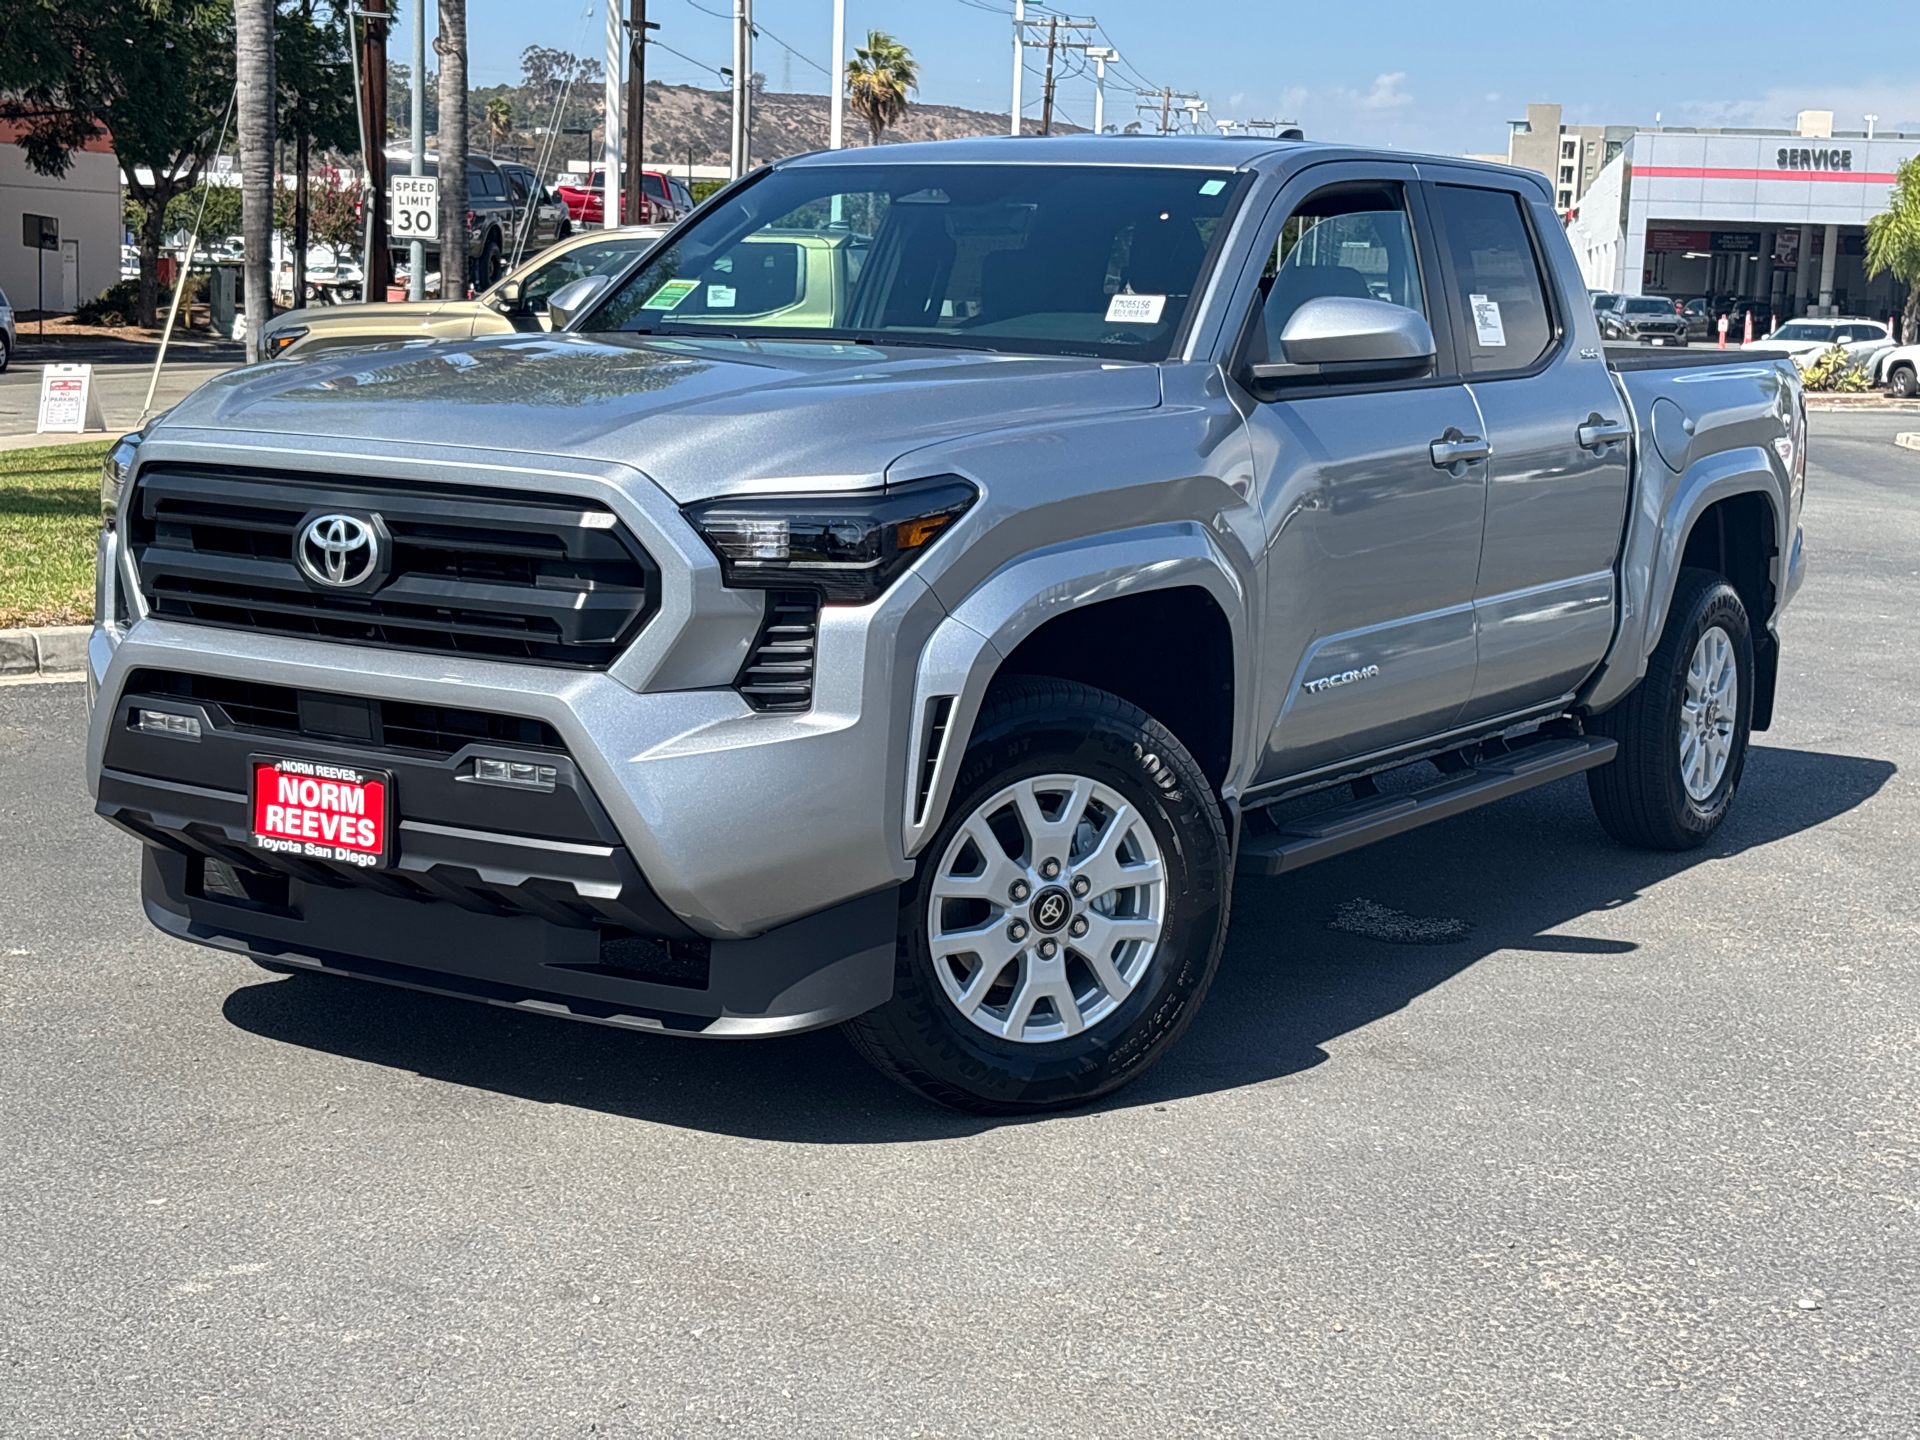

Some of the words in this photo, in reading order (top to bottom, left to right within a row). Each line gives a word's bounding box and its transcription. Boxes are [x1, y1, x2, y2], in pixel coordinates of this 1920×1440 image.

[1777, 148, 1852, 169] SERVICE
[395, 182, 435, 193] SPEED
[398, 195, 432, 207] LIMIT
[397, 210, 432, 232] 30
[60, 390, 71, 398] NO
[1302, 664, 1380, 694] TACOMA
[282, 760, 314, 776] NORM
[315, 765, 357, 782] REEVES
[278, 776, 365, 815] NORM
[265, 804, 376, 847] REEVES
[255, 834, 302, 852] Toyota
[304, 842, 332, 859] San
[335, 847, 377, 868] Diego
